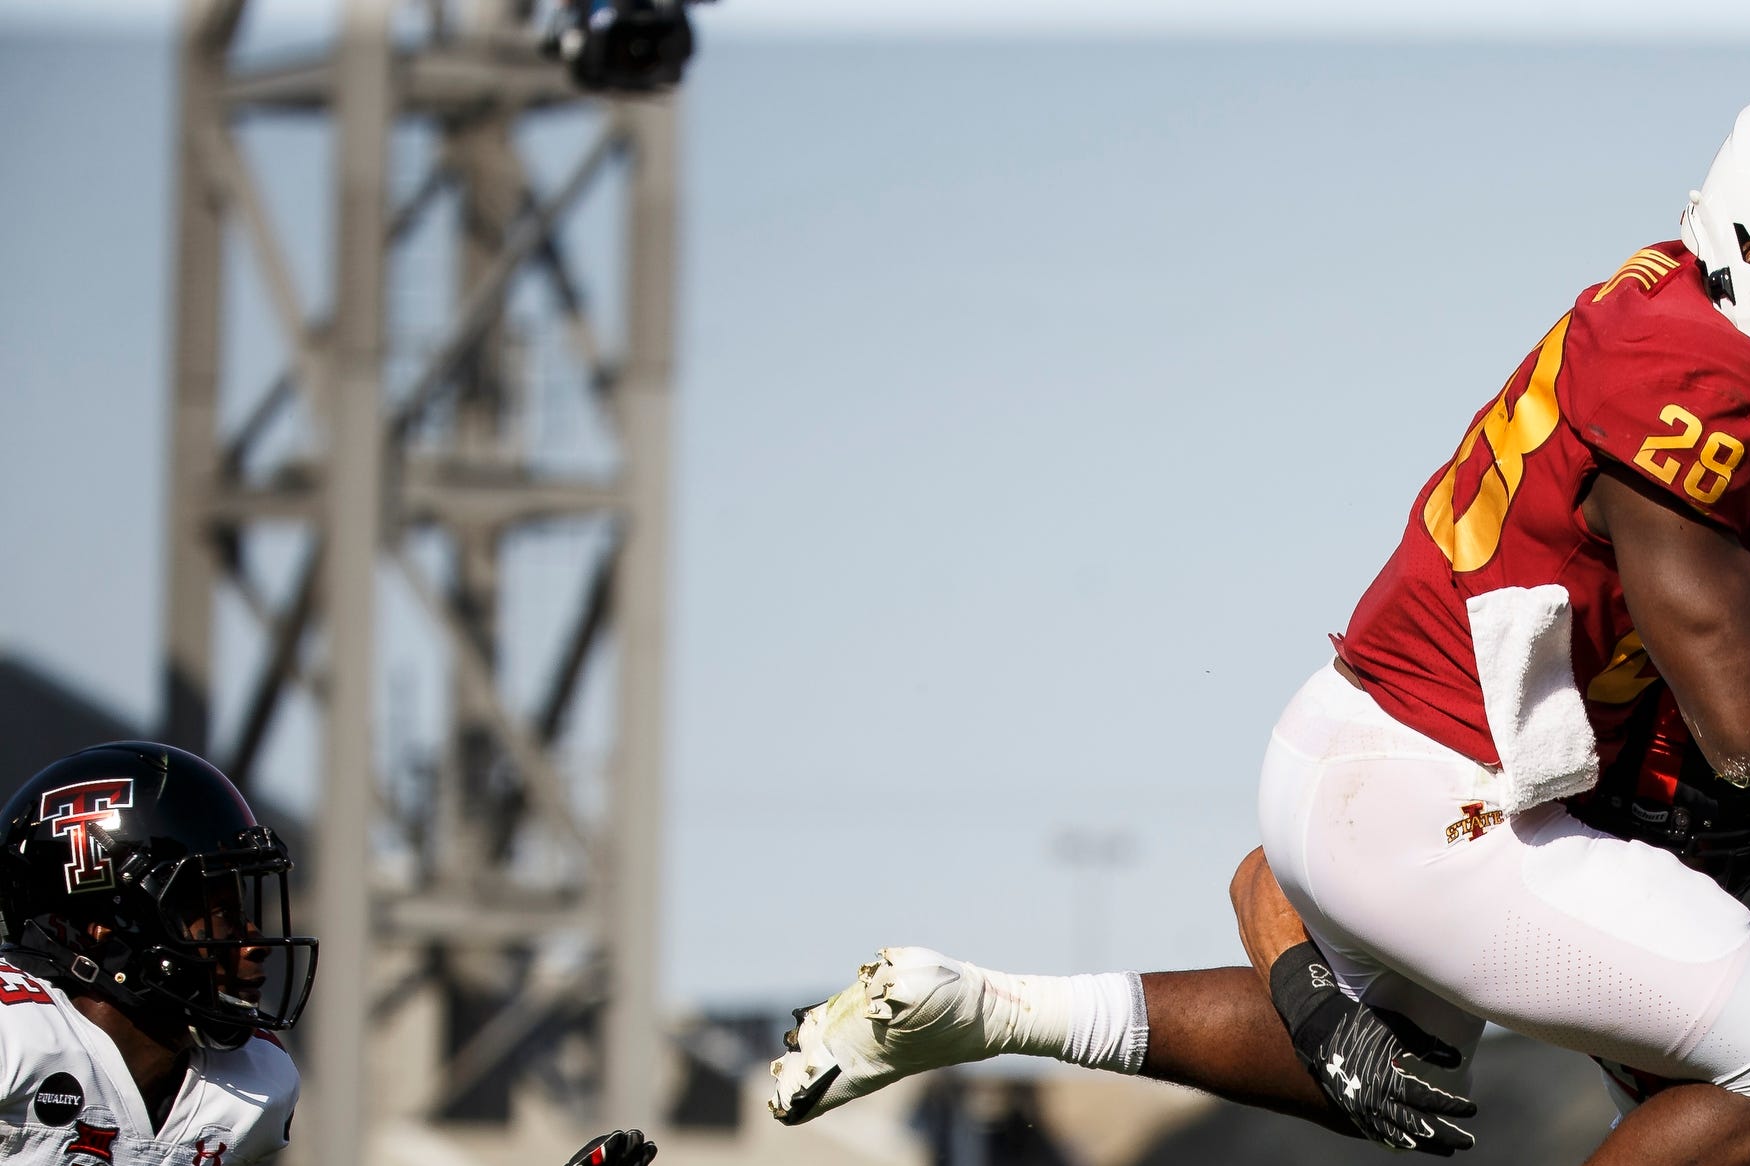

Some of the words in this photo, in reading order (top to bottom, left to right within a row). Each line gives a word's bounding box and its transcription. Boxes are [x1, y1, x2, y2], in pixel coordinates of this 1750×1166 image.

[1632, 403, 1745, 504] 28
[1446, 810, 1504, 844] STATE
[37, 1092, 81, 1106] EQUALITY
